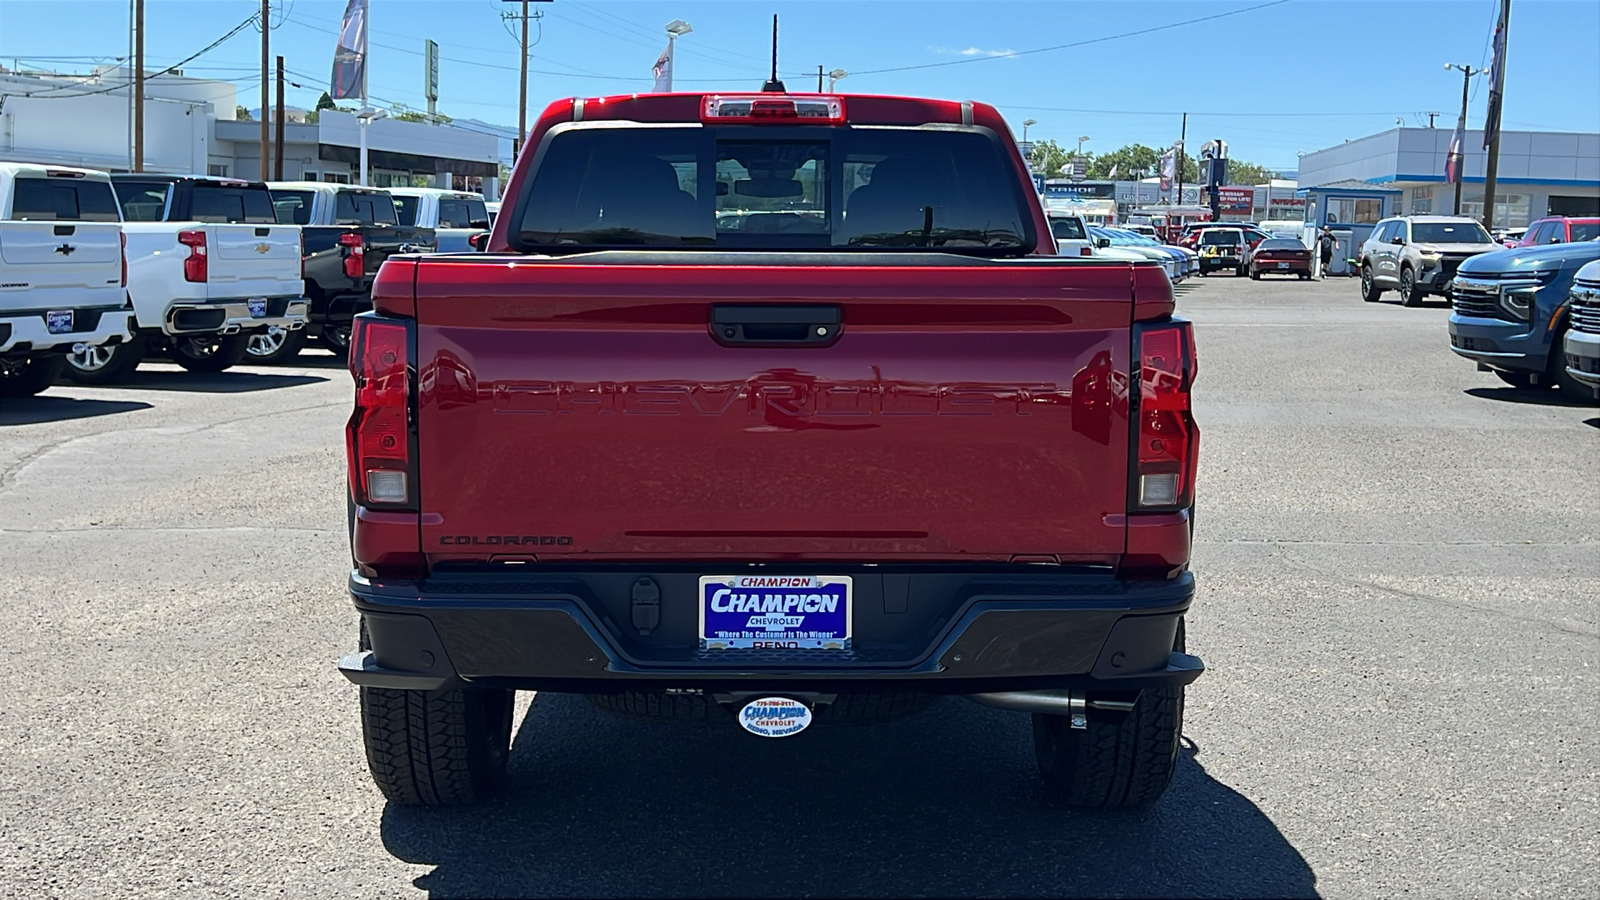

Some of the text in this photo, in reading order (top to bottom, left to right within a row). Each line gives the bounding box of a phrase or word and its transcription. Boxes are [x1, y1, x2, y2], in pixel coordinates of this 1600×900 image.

[493, 380, 1057, 416] CHEVROLET
[439, 535, 574, 546] COLORADO
[740, 577, 811, 587] CHAMPION
[710, 588, 839, 613] CHAMPION
[750, 617, 801, 625] CHEVROLET
[715, 631, 838, 639] "Where The Customer Is The Winner"
[752, 641, 799, 650] RENO
[744, 706, 806, 719] CHAMPION
[746, 723, 804, 736] RENO, NEVADA
